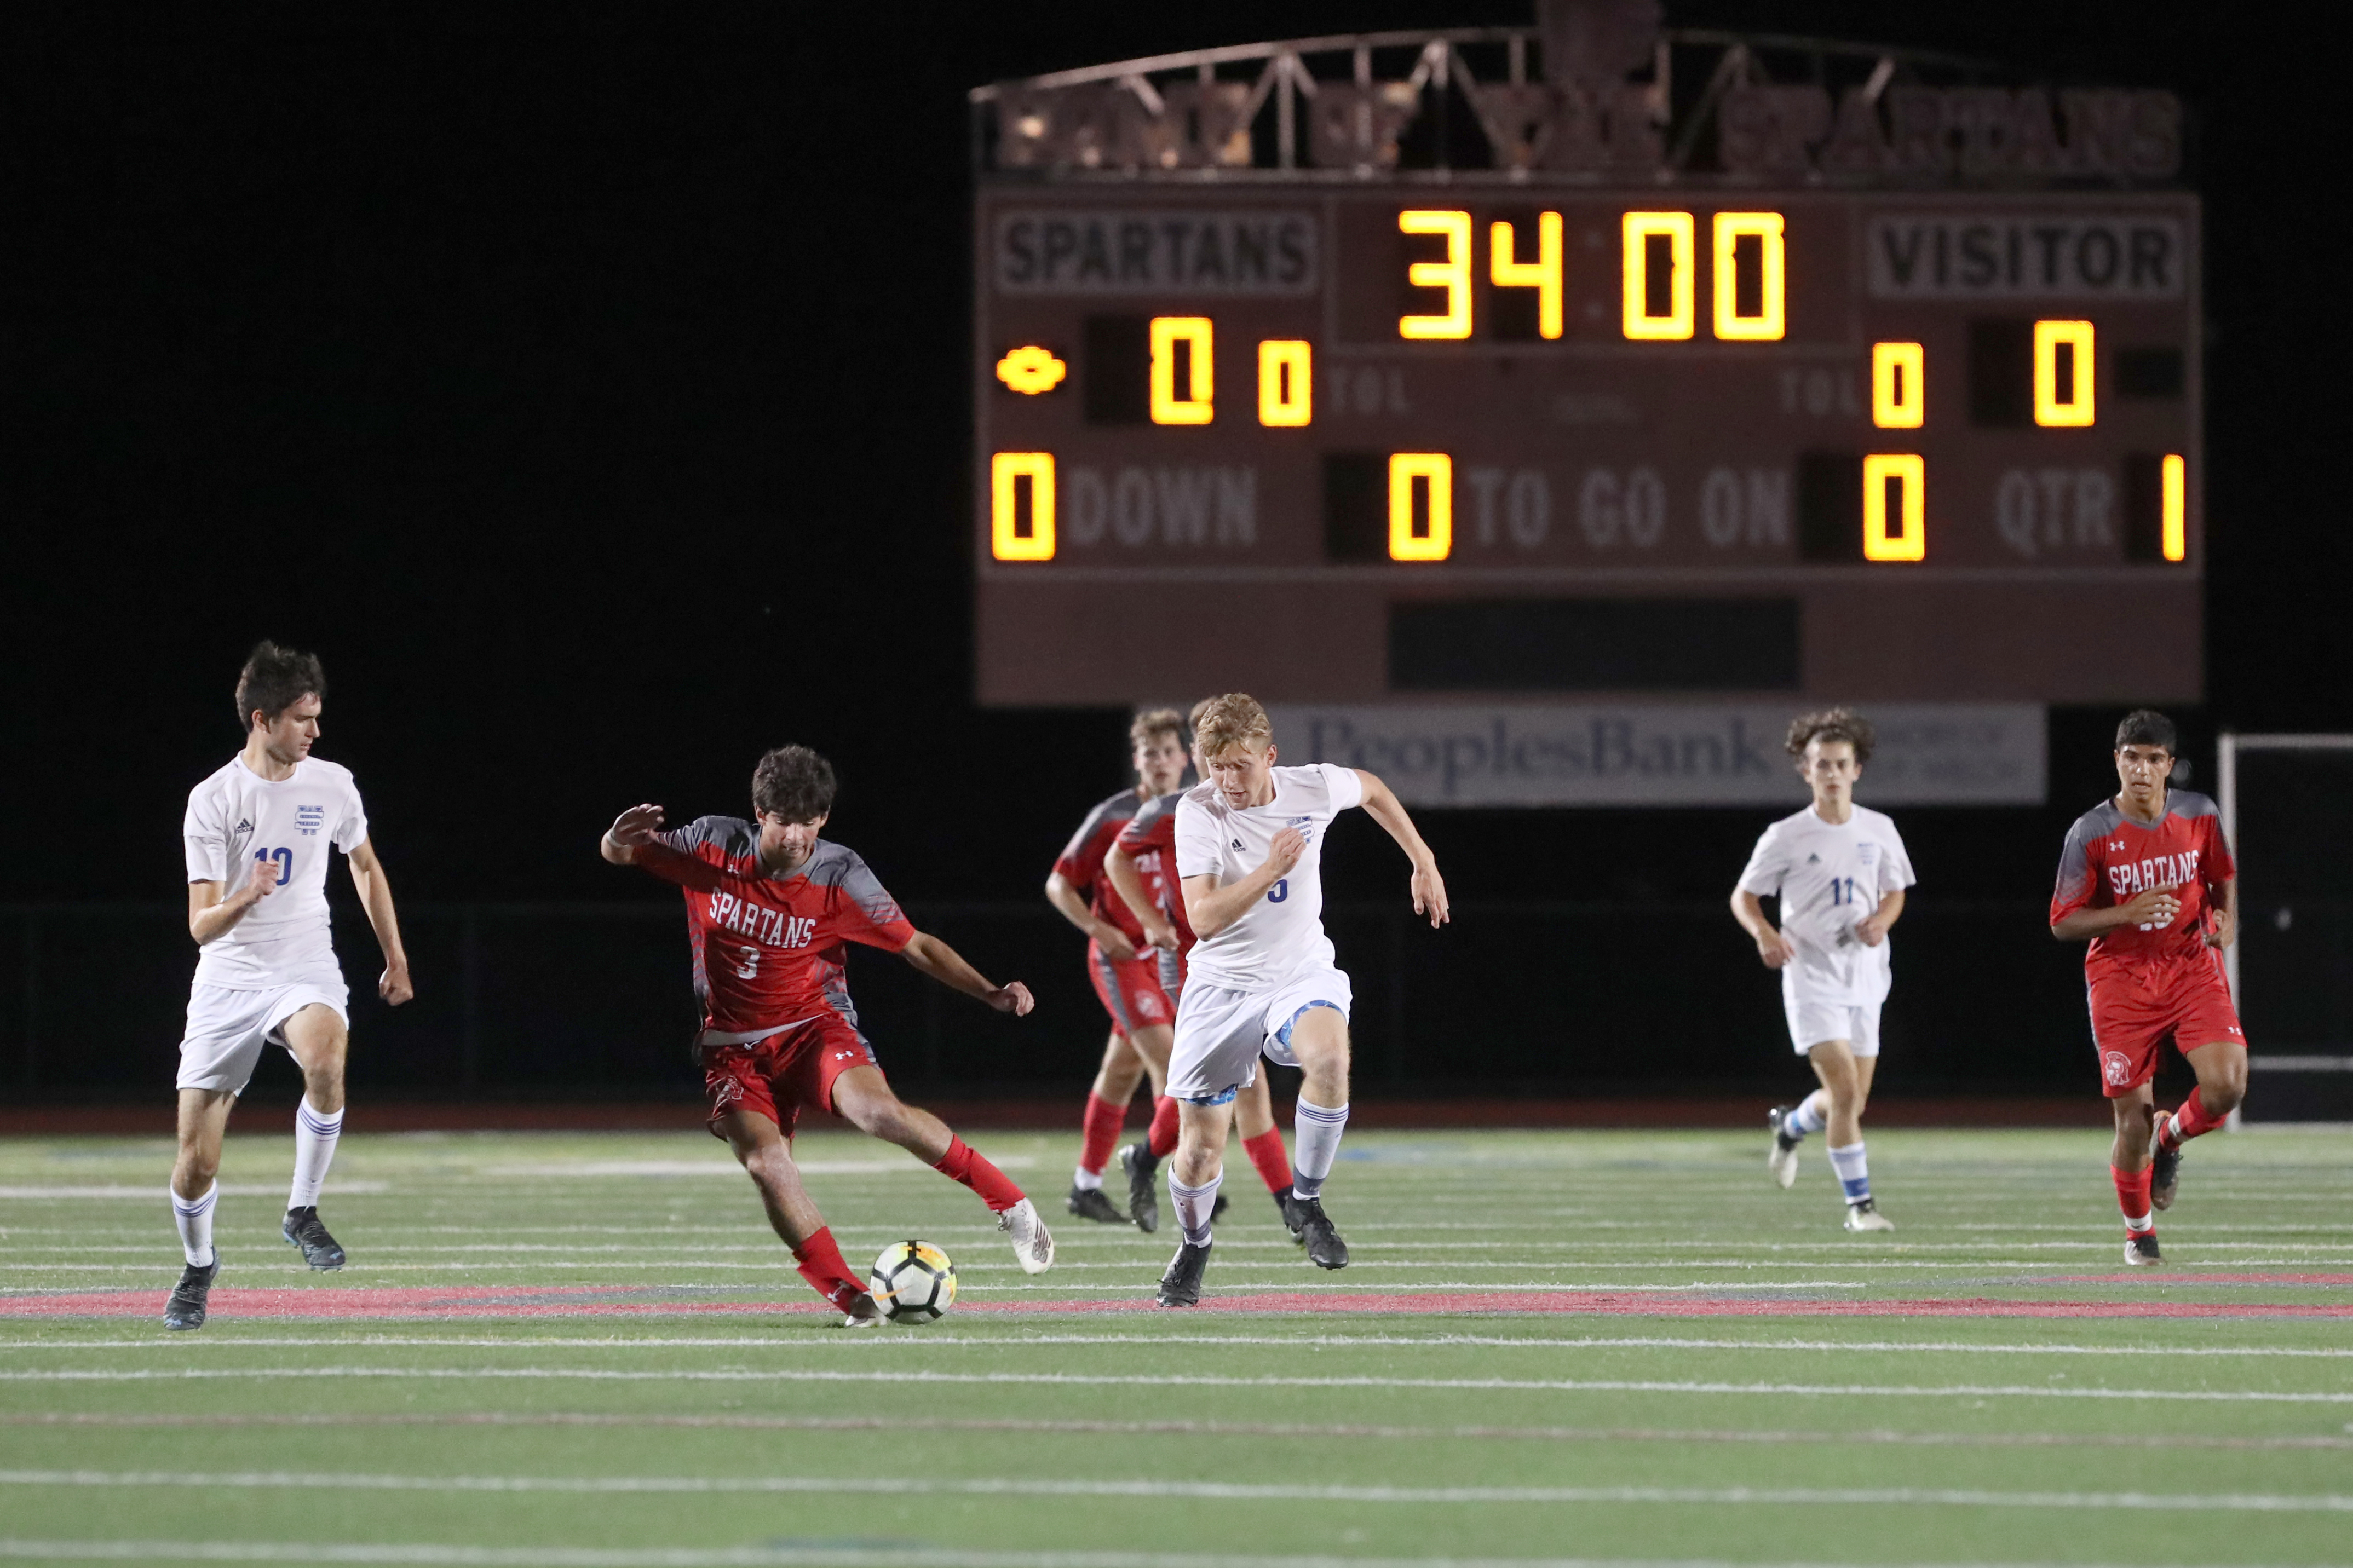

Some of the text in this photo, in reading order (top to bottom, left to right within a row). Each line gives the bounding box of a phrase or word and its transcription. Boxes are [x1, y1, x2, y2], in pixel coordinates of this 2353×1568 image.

[1008, 220, 1307, 284] SPARTANS
[1883, 224, 2169, 289] VISITOR
[1149, 316, 1213, 425] 0
[1258, 340, 1312, 427] 0
[1326, 367, 1410, 414] TOL
[1872, 342, 1924, 429] 0
[2033, 320, 2095, 427] 0
[991, 452, 1056, 561] 0
[1070, 466, 1256, 545] DOWN
[1388, 453, 1452, 561] 0
[1469, 466, 1788, 547] TO GO ON
[1863, 454, 1925, 562] 0
[1995, 468, 2116, 558] QTR
[2162, 454, 2185, 562] 1
[1308, 716, 1770, 796] PeoplesBank
[1830, 876, 1853, 905] 11
[2109, 849, 2200, 895] SPARTANS
[709, 886, 816, 948] SPARTANS
[737, 946, 761, 979] 3
